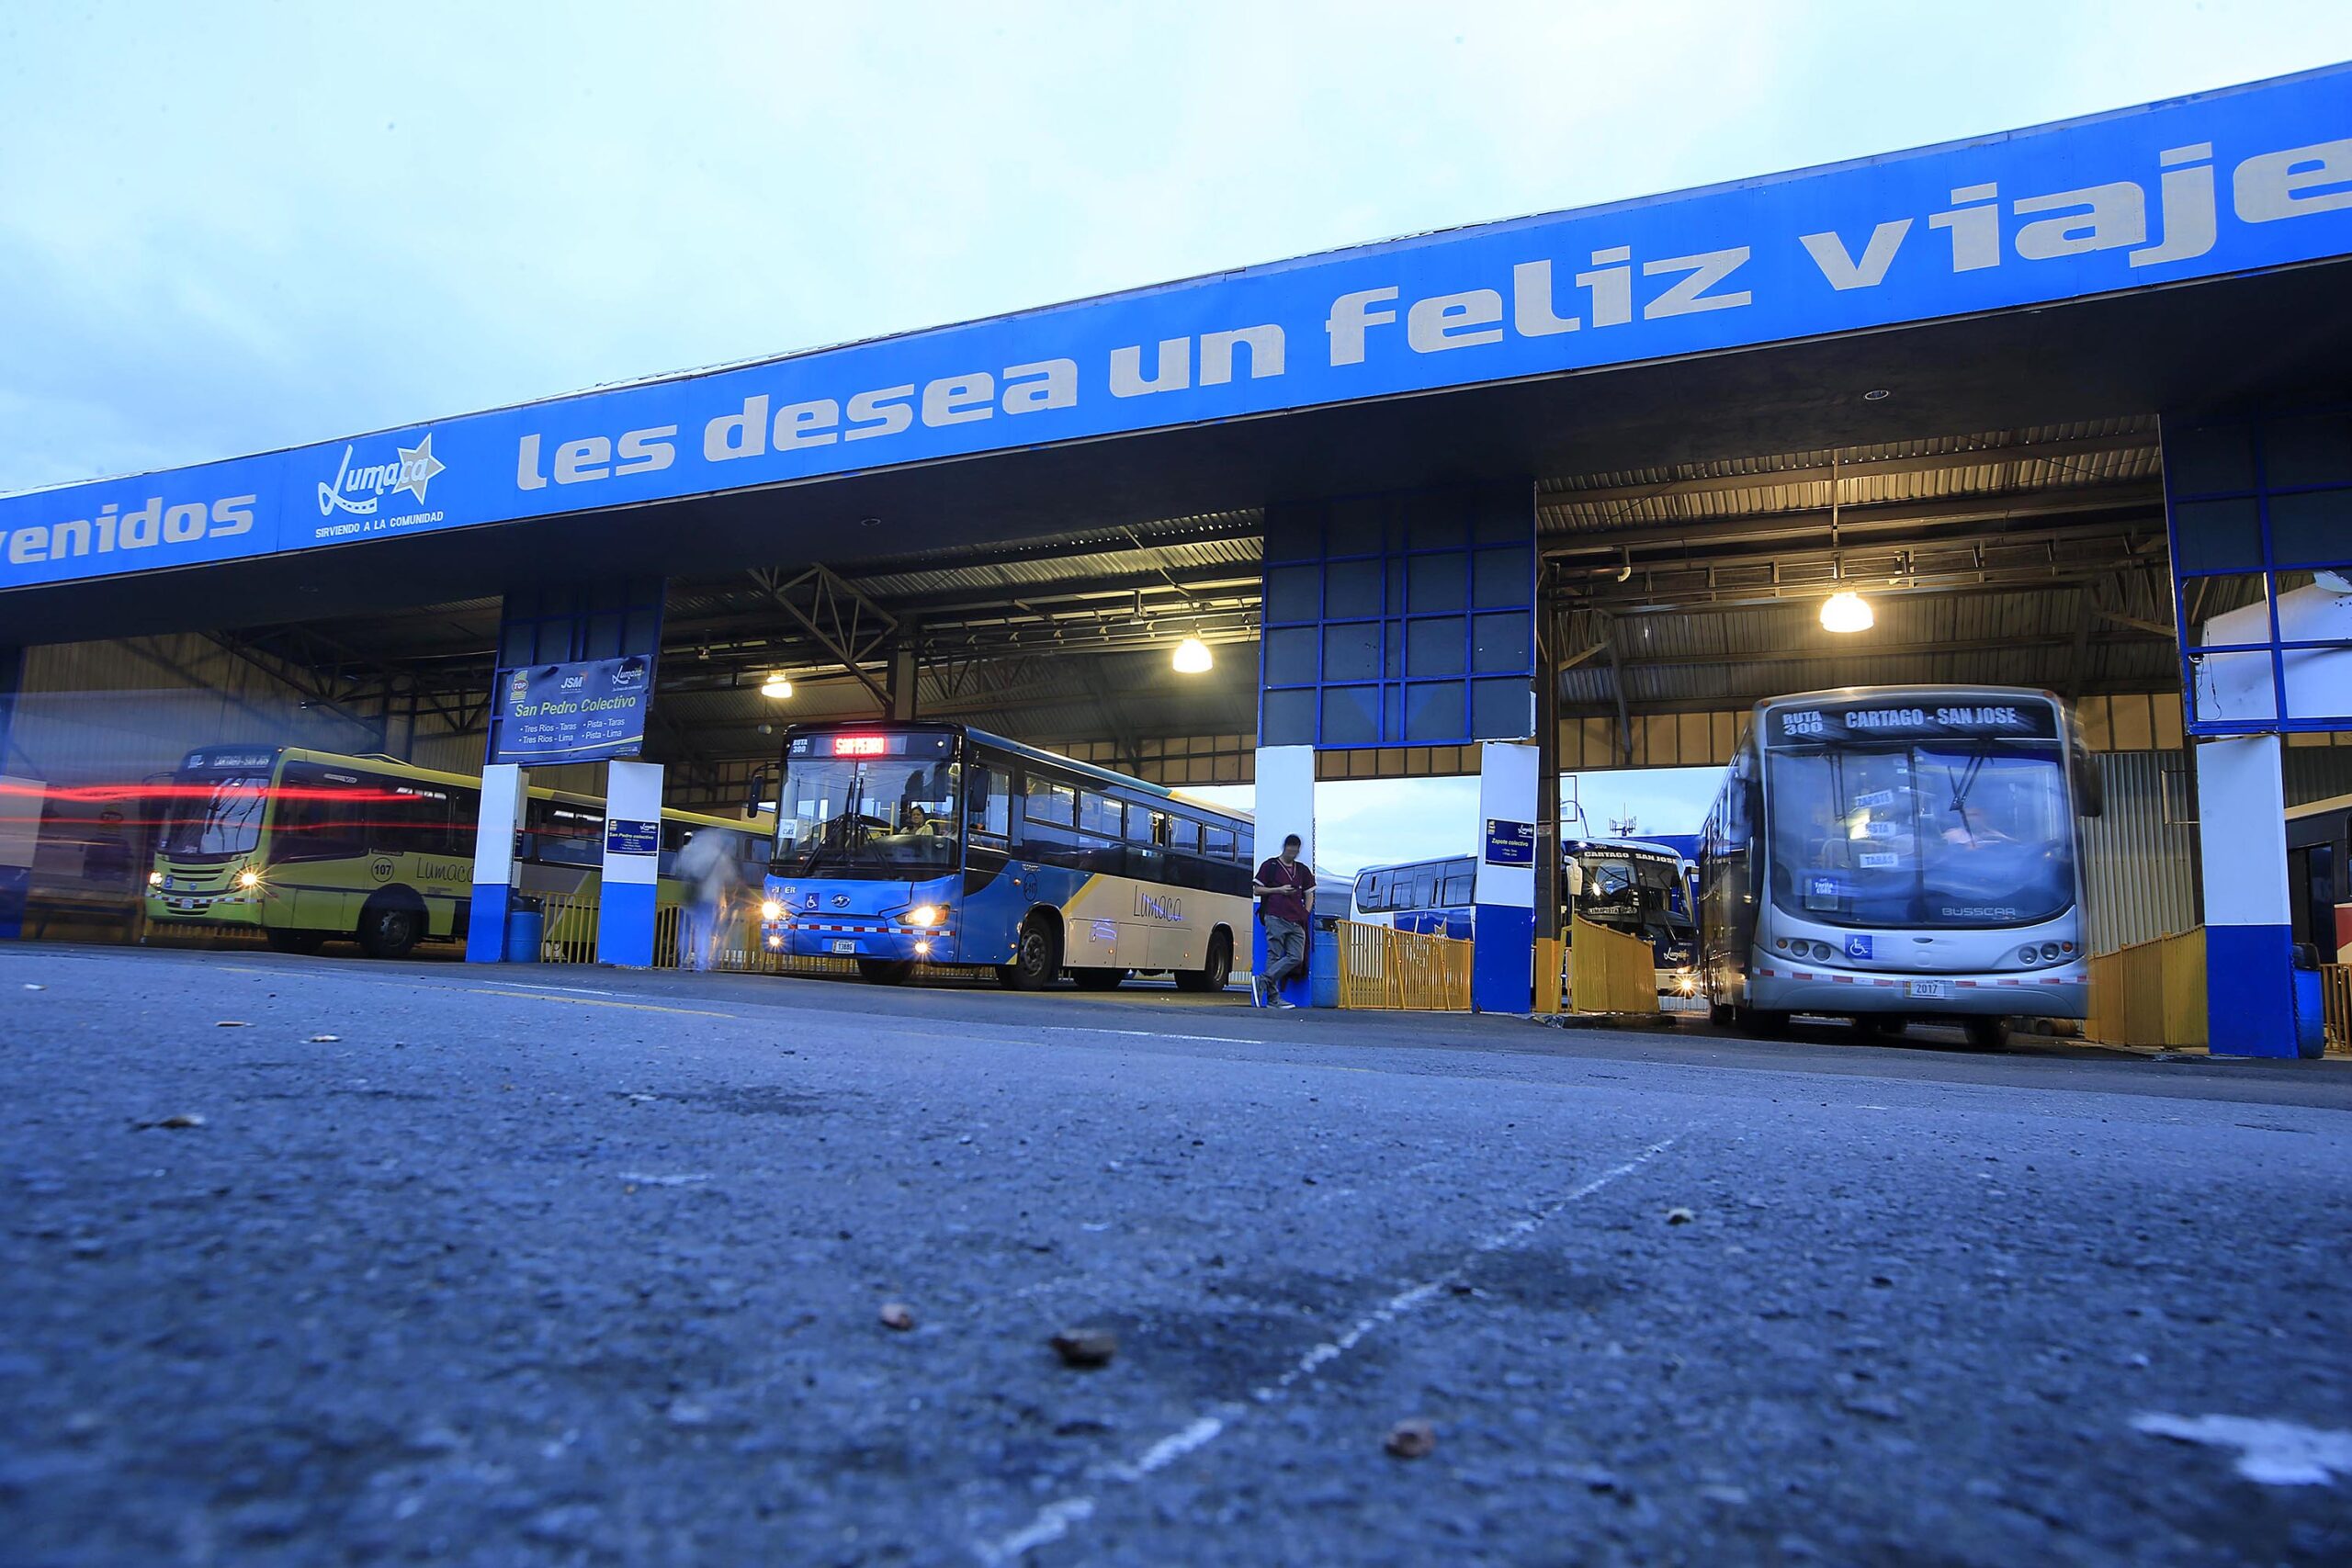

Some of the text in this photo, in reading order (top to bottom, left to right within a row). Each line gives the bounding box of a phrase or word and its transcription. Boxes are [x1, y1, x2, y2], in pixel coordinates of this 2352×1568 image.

[516, 138, 2352, 491] les desea un feliz viaje
[318, 445, 429, 516] Lumaca
[0, 494, 256, 564] enidos
[315, 511, 444, 538] SIRVIENDO A LA COMUNIDAD
[514, 682, 526, 690] TOP
[560, 676, 583, 689] JSM
[514, 694, 637, 717] San Pedro Colectivo
[587, 720, 603, 728] Pista
[608, 717, 626, 727] Taras
[1782, 711, 1823, 725] RUTA
[1845, 709, 1924, 728] CARTAGO
[1937, 708, 1973, 725] SAN
[1975, 707, 2018, 724] JOSE
[524, 725, 538, 733] Tres
[560, 722, 577, 731] Taras
[585, 731, 602, 739] Pista
[606, 729, 622, 739] Lima
[1783, 722, 1824, 736] 300
[523, 736, 537, 744] Tres
[558, 733, 574, 742] Lima
[1635, 852, 1655, 862] SAN
[374, 865, 392, 875] 107
[1134, 885, 1182, 921] Lumaca
[1941, 908, 2016, 916] BUSSCAR
[1916, 984, 1938, 994] 2017
